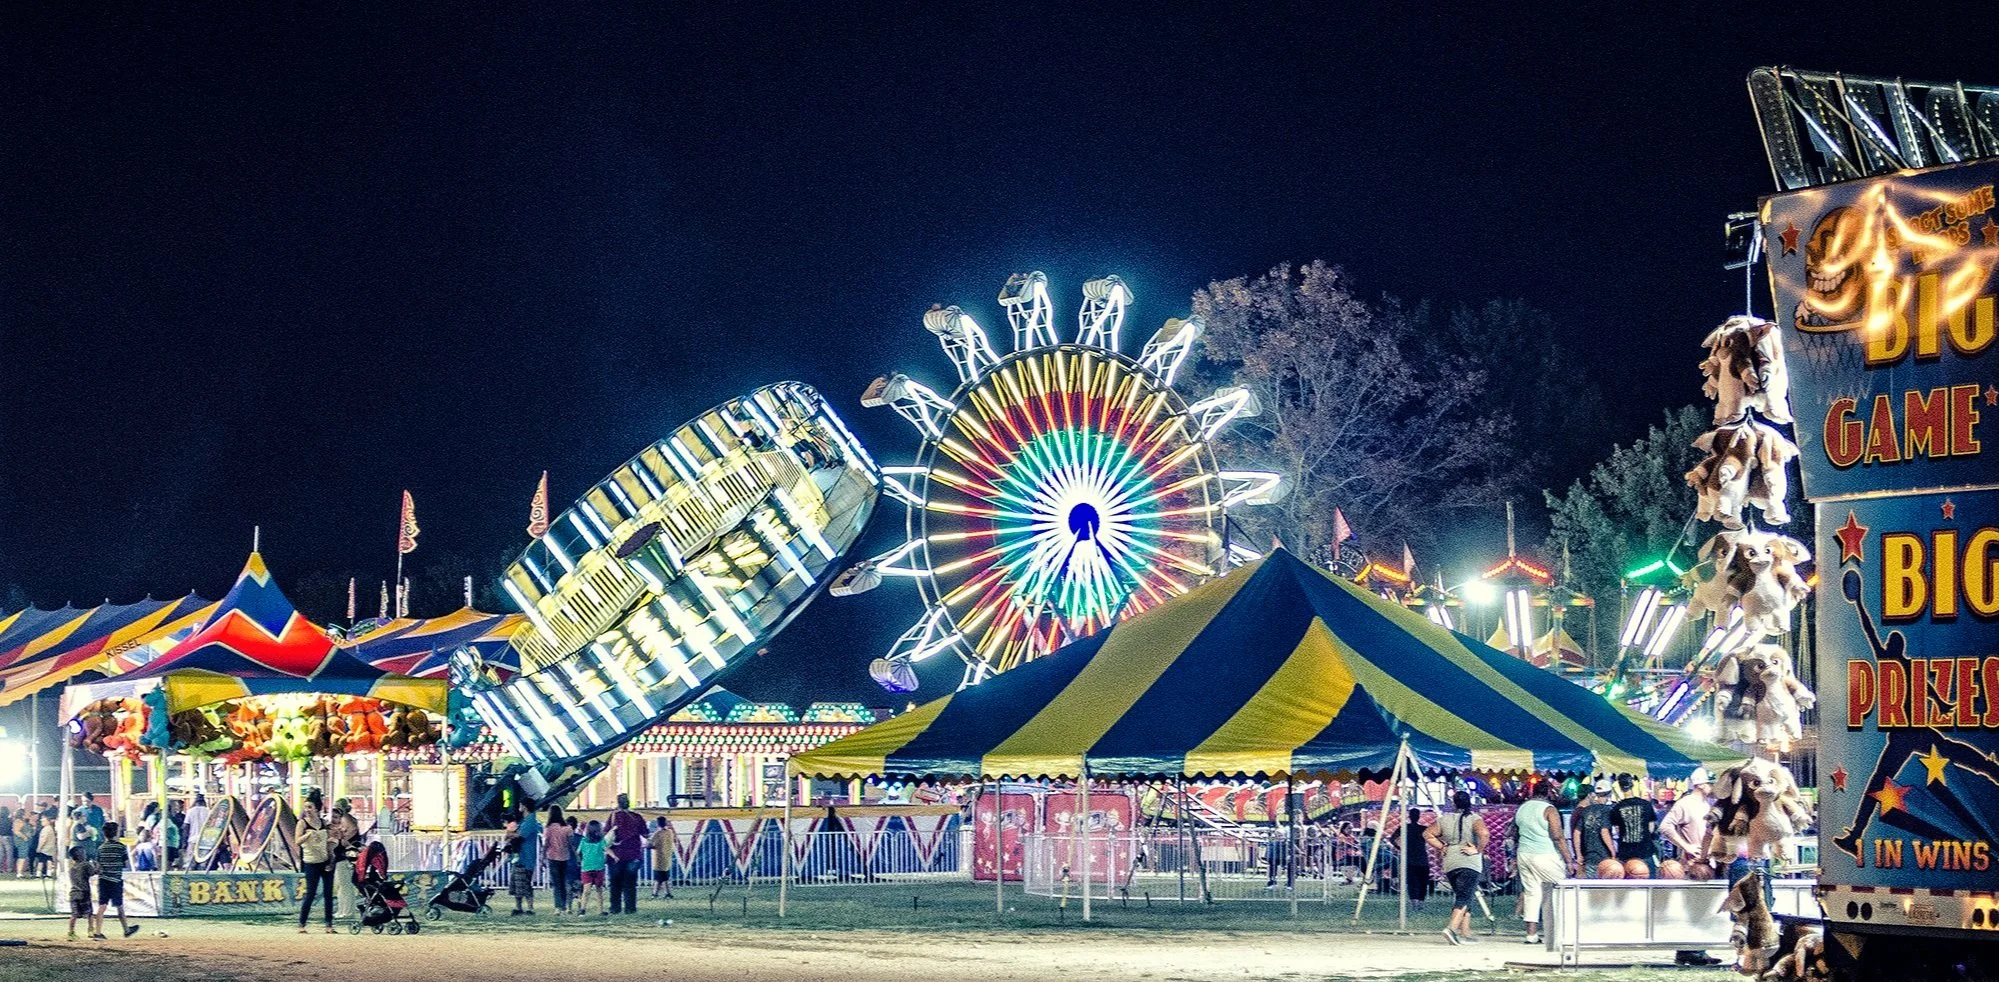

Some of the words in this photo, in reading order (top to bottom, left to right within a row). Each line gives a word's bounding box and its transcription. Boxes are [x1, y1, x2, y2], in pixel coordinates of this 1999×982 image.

[1824, 384, 1981, 467] GAME
[1881, 527, 1999, 619] BIG
[105, 639, 142, 659] KISSEL
[1847, 656, 1999, 727] PRIZES
[1874, 839, 1903, 869] IN
[1912, 840, 1990, 871] WINS
[189, 879, 285, 905] BANK
